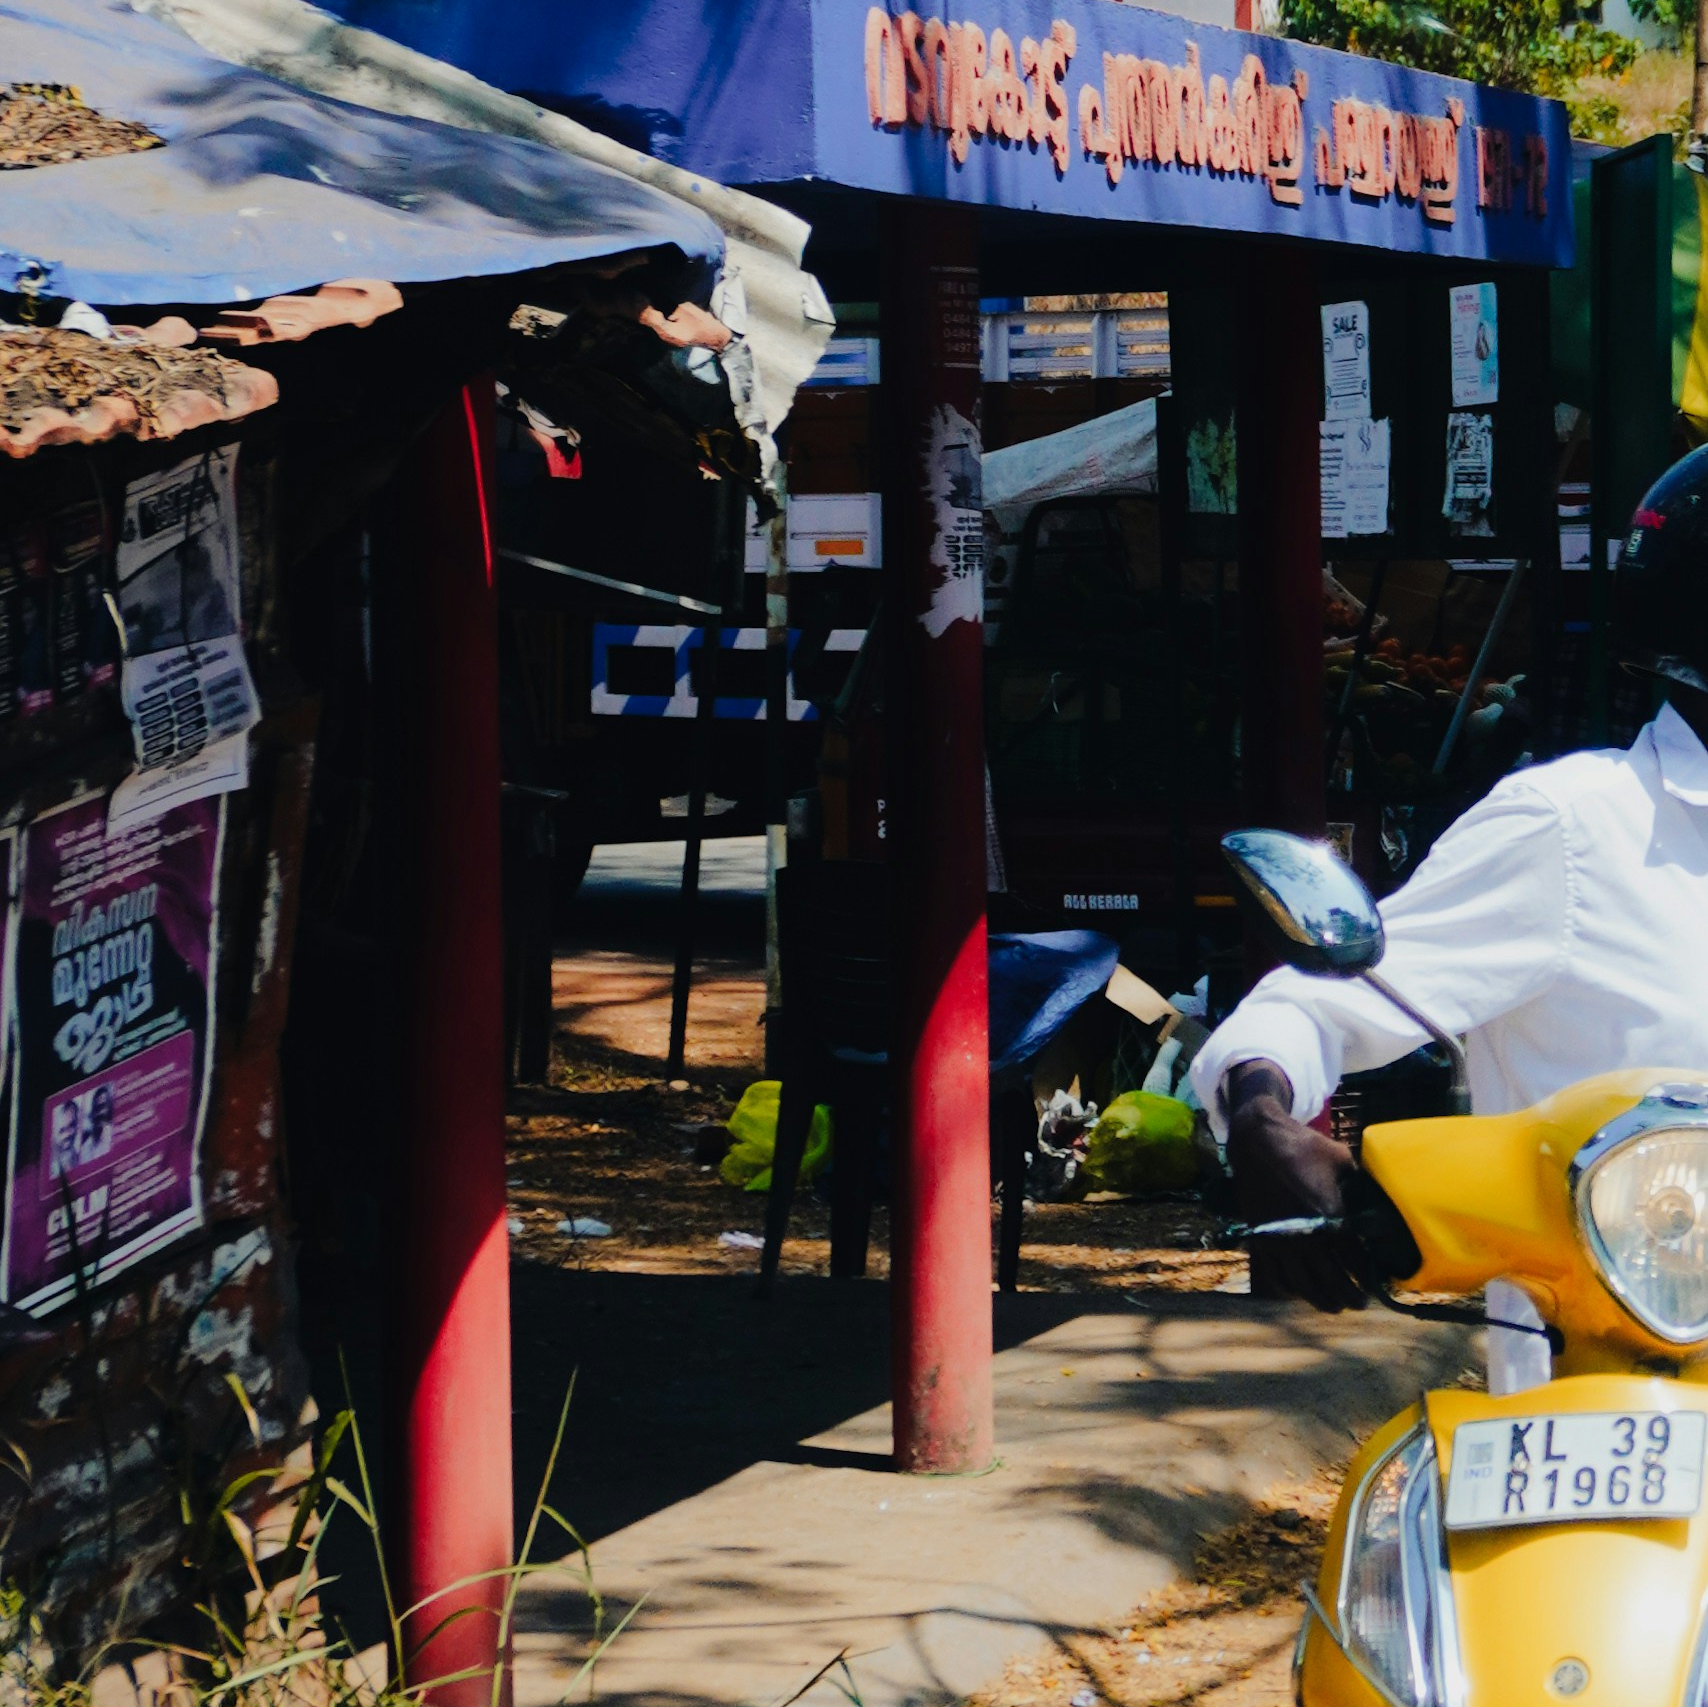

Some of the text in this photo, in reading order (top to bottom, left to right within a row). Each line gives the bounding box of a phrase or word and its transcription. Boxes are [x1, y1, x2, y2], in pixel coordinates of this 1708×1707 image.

[1333, 314, 1358, 334] SALE
[1088, 894, 1139, 910] KERALA
[1509, 1415, 1670, 1462] KL 39
